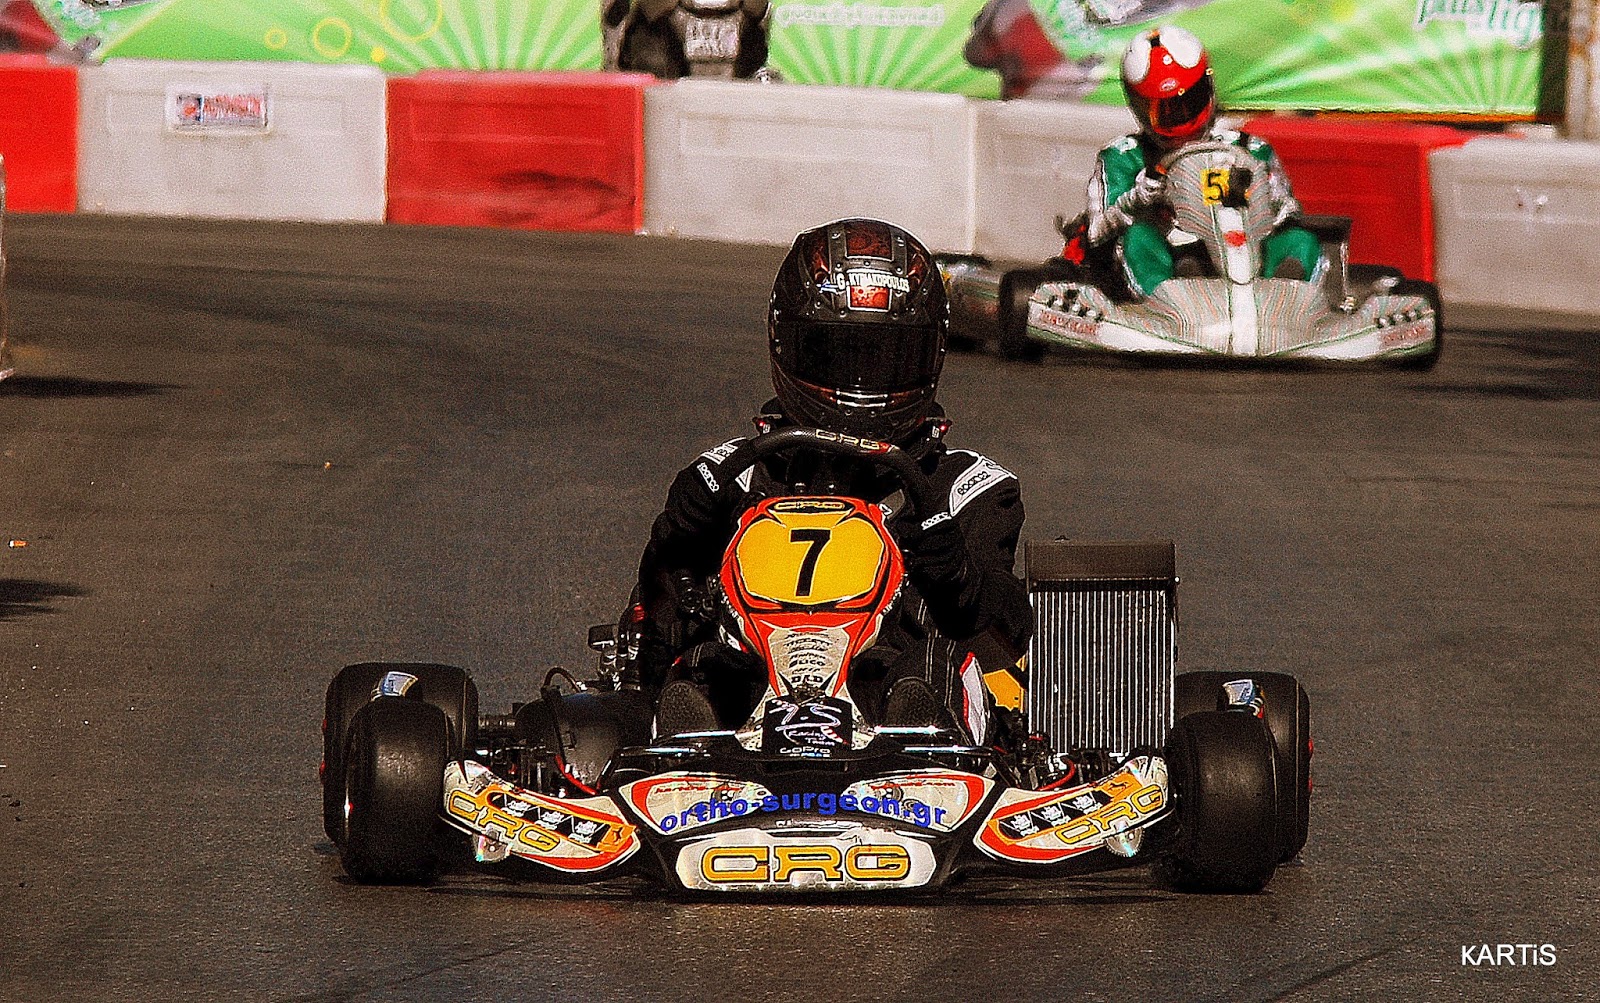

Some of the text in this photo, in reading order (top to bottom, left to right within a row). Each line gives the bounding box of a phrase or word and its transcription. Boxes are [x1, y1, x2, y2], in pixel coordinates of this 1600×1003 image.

[790, 528, 832, 598] 7
[449, 789, 561, 852] CRG
[660, 791, 949, 832] ortho-surgeon.gr
[1054, 784, 1165, 845] CRG
[700, 845, 912, 883] CRG
